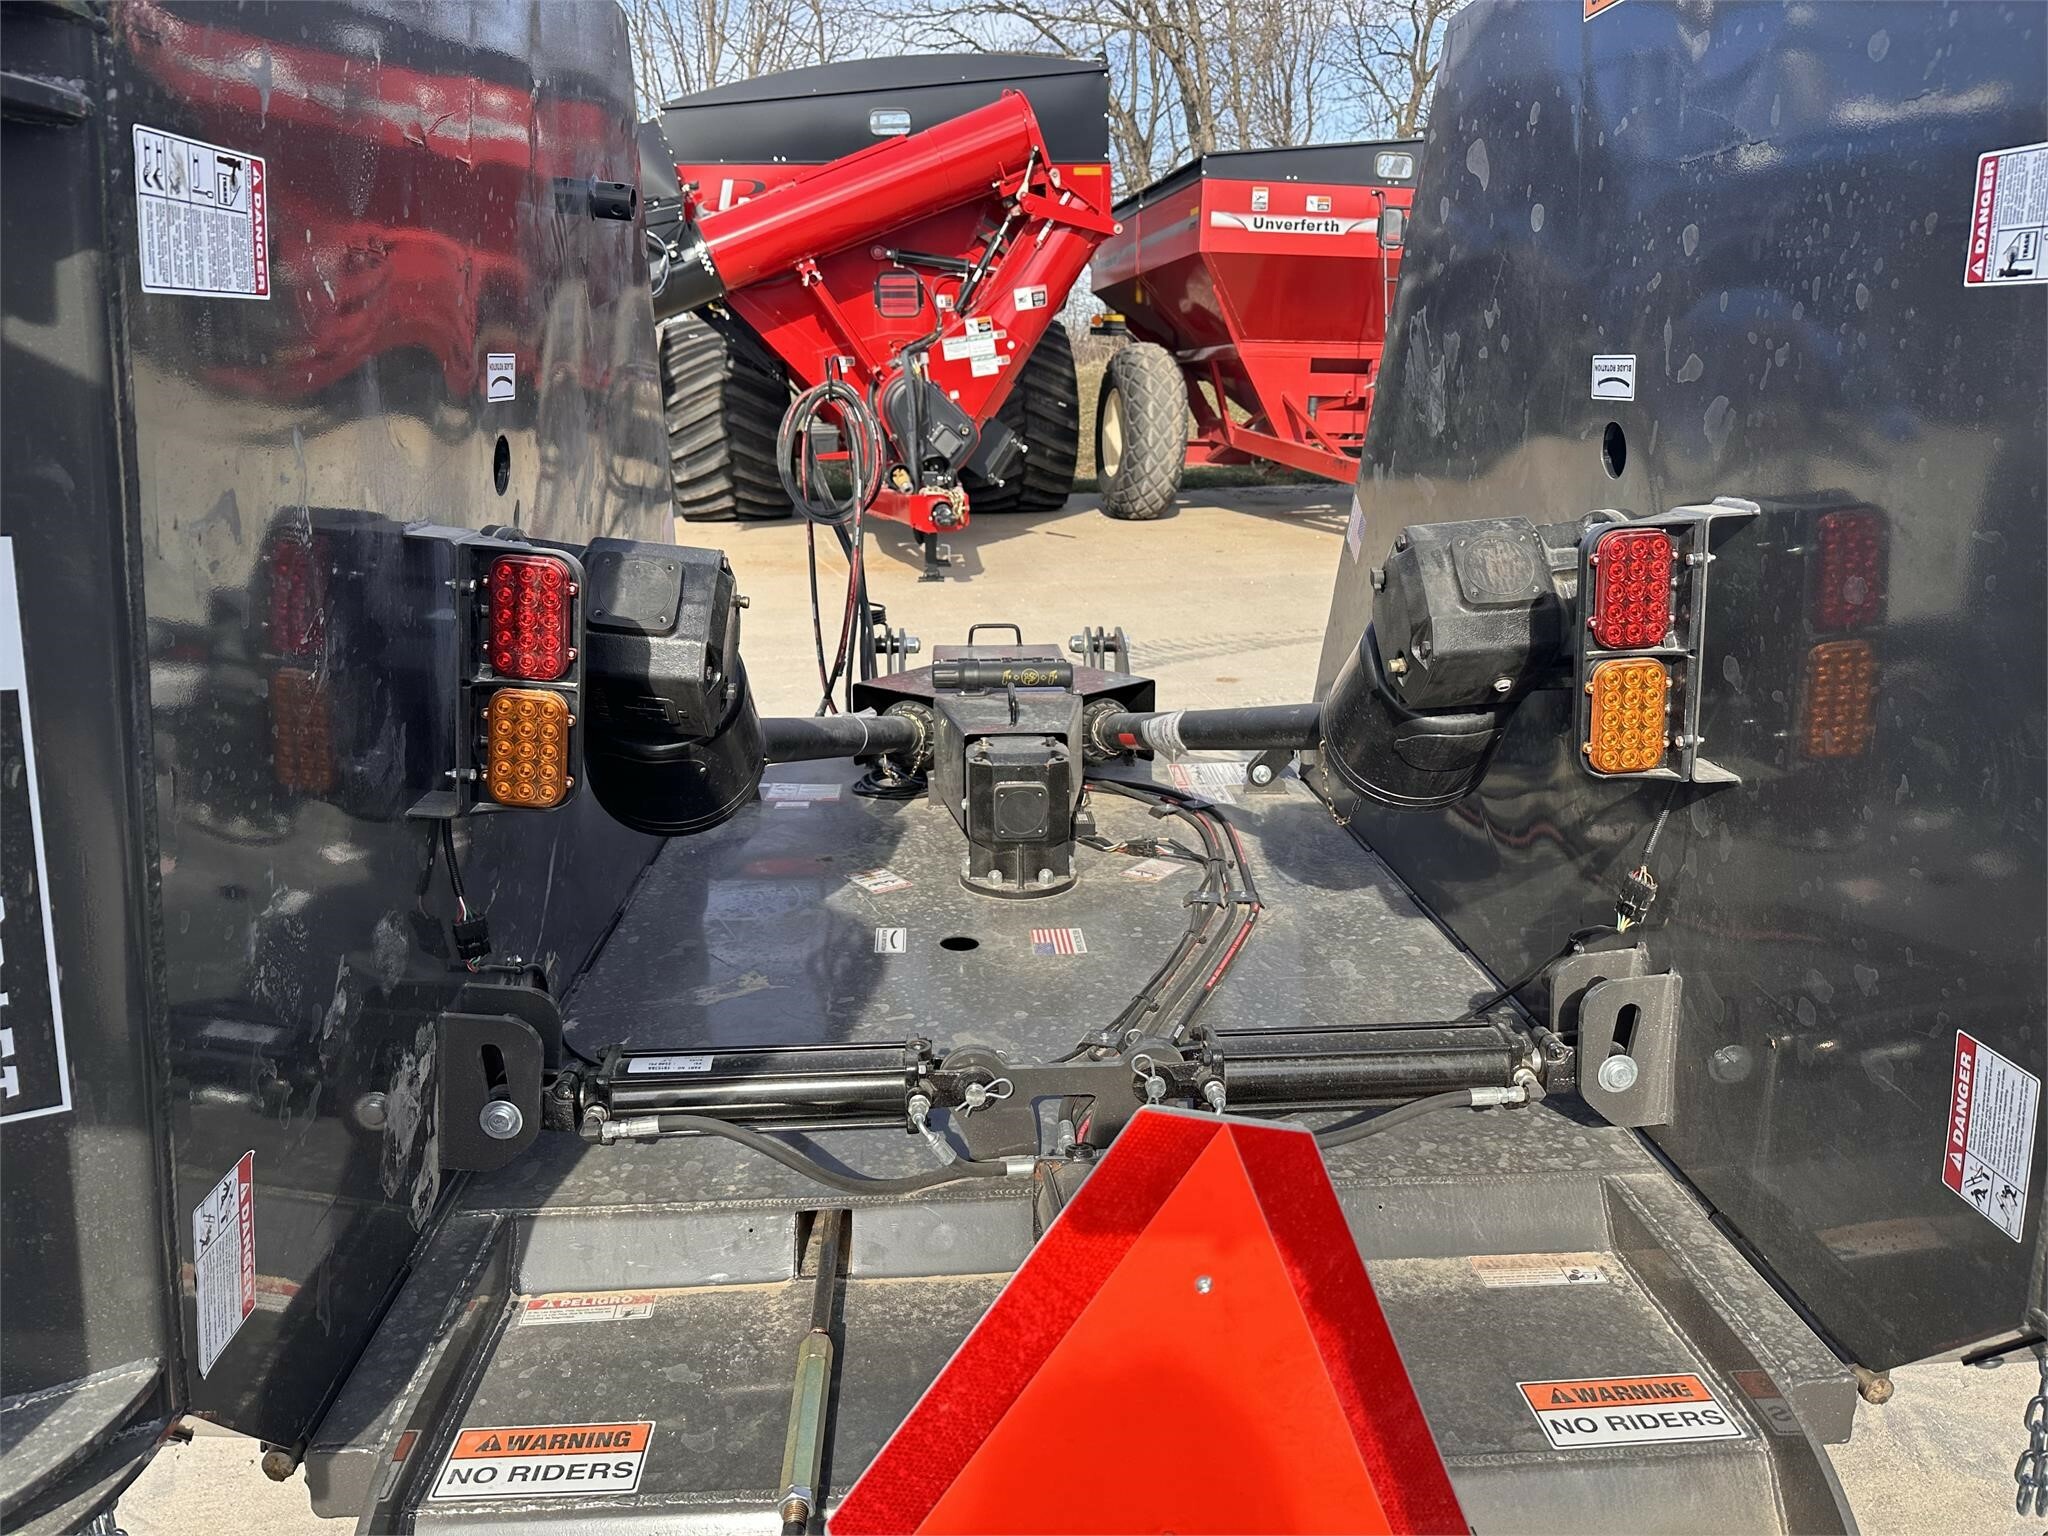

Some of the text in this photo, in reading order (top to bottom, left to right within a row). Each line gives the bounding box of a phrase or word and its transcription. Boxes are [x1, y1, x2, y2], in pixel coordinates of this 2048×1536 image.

[1974, 160, 1996, 254] DANGER
[1253, 217, 1339, 232] Unverferth
[254, 192, 266, 291] DANGER
[2021, 233, 2031, 259] TRASH
[1594, 364, 1632, 373] BLADE ROTATION
[1953, 1051, 1971, 1147] DANGER
[240, 1202, 253, 1299] DANGER
[559, 1296, 634, 1307] PELIGRO
[1571, 1382, 1694, 1403] WARNING
[1549, 1409, 1726, 1435] NO RIDERS
[507, 1431, 632, 1451] WARNING
[447, 1461, 634, 1485] NO RIDERS
